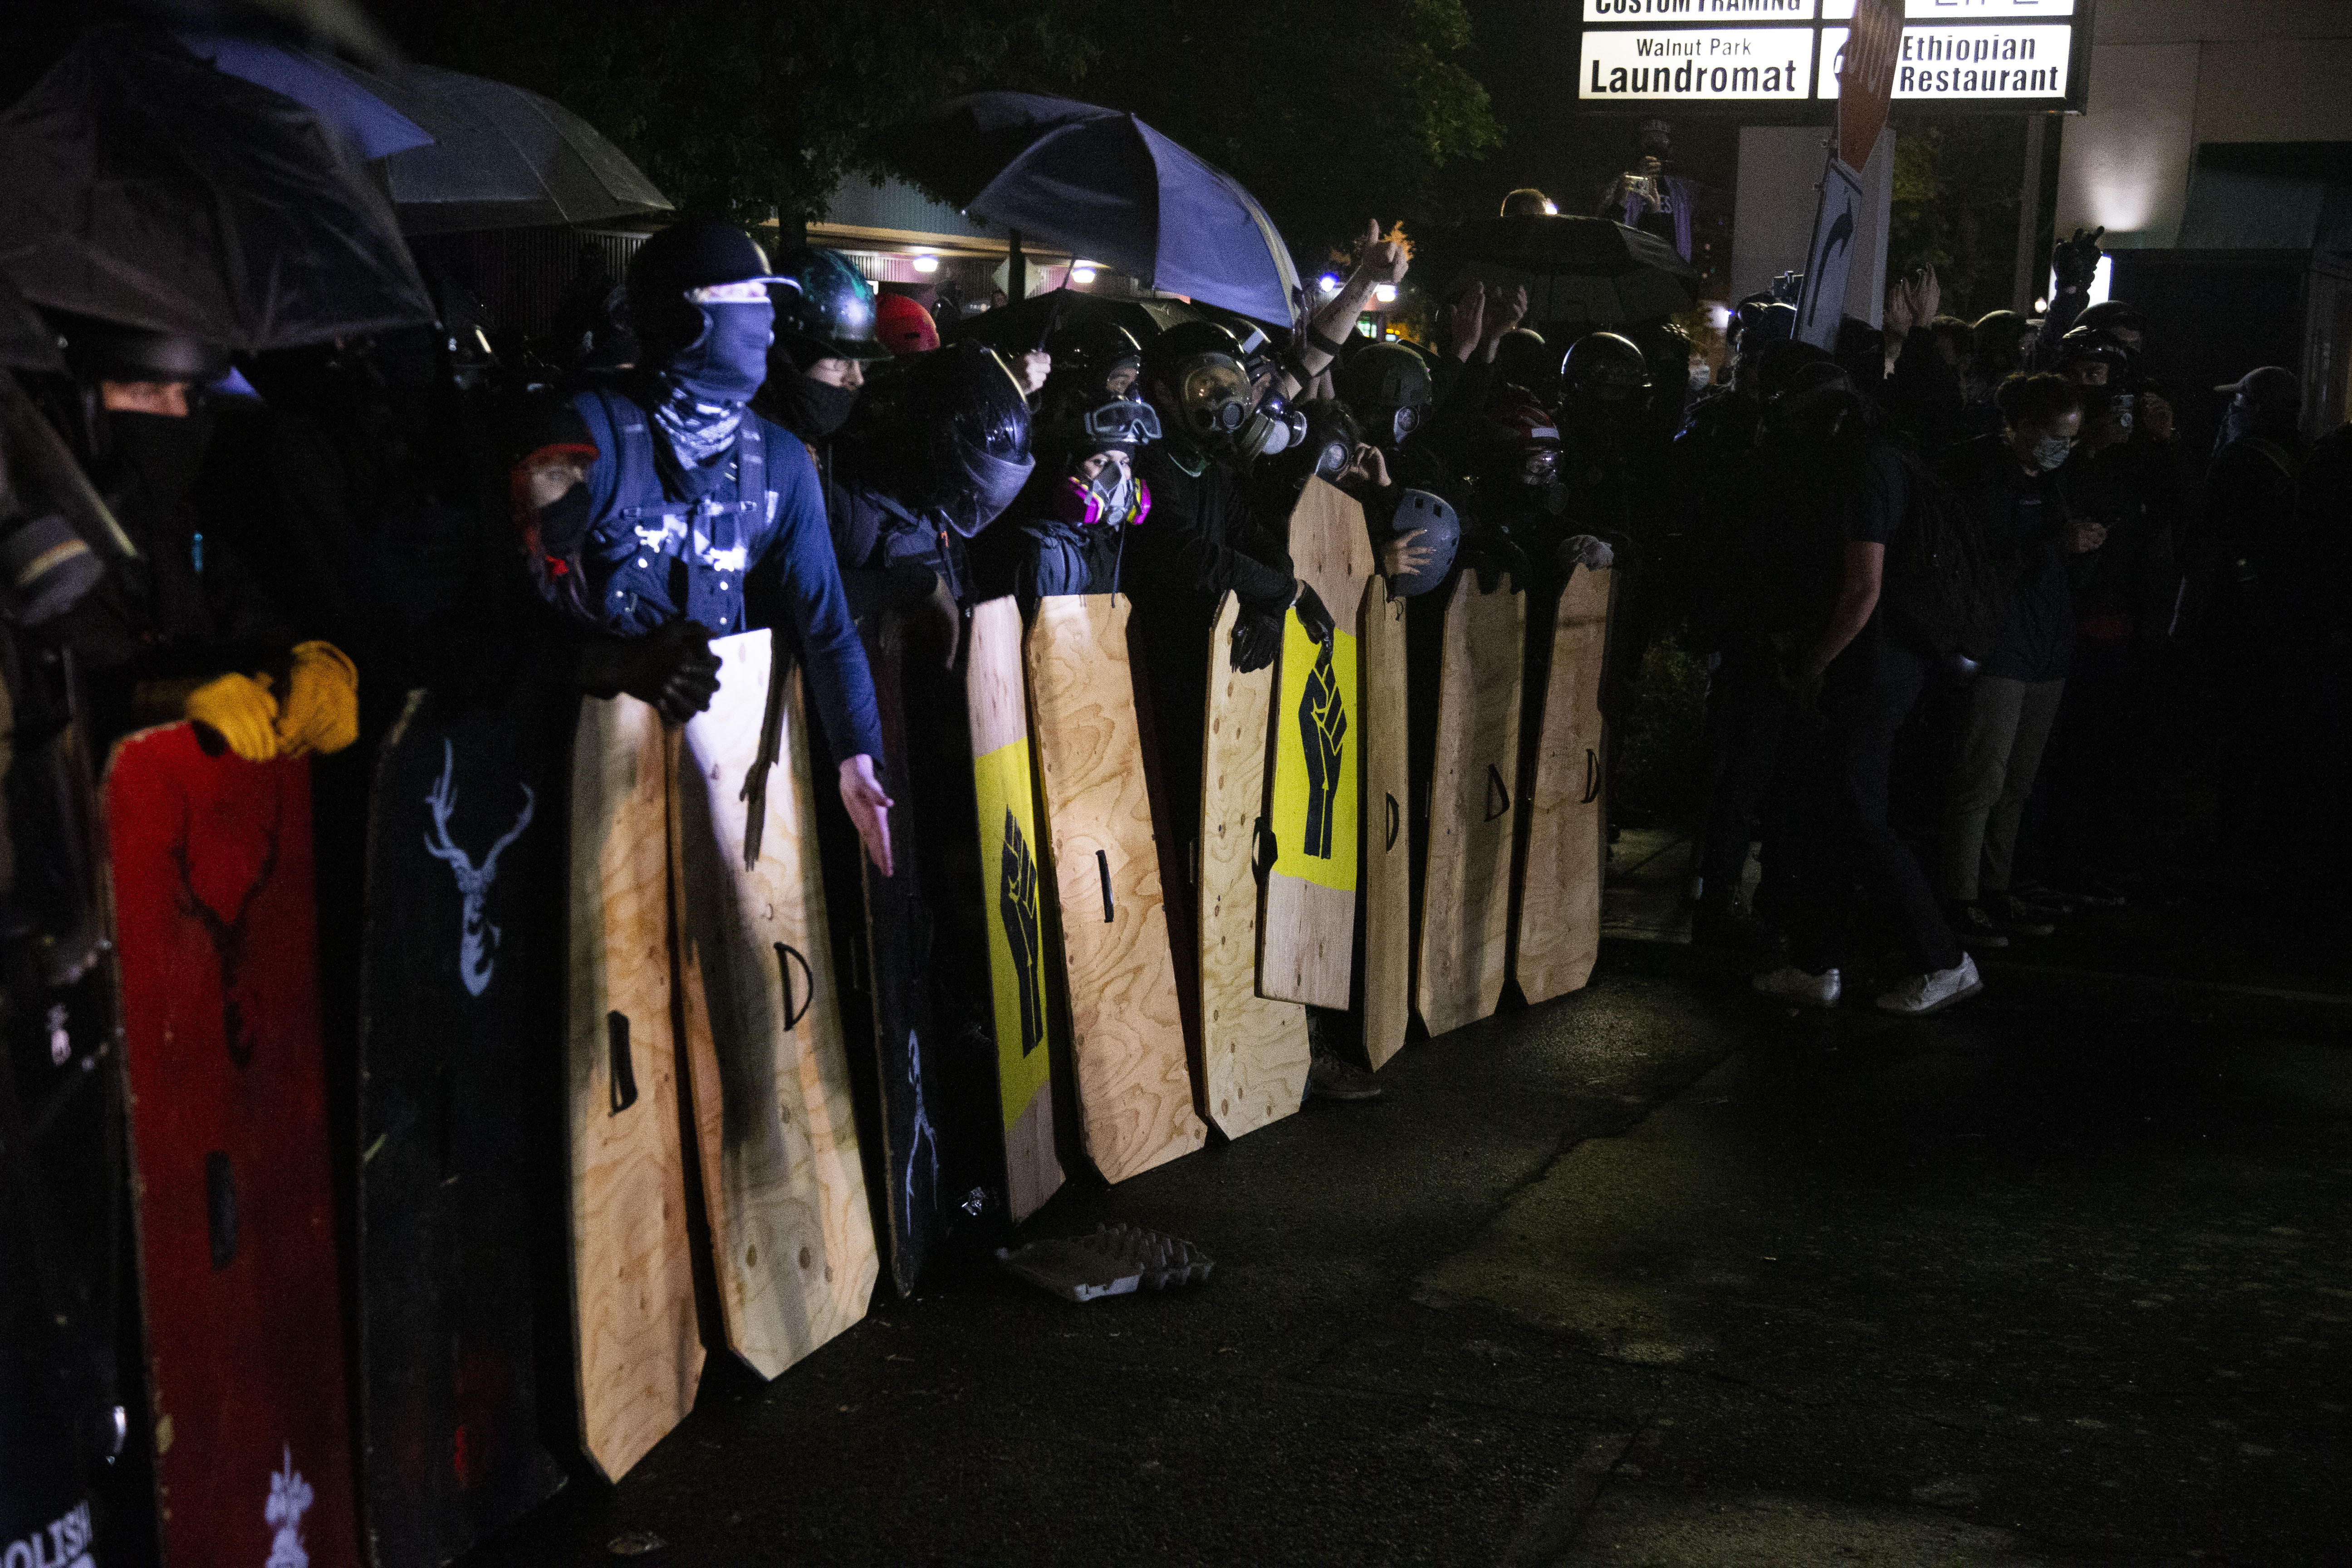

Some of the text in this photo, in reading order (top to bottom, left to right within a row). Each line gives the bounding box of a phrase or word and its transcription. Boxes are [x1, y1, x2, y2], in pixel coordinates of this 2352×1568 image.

[1637, 38, 1752, 56] Walnut Park
[1902, 35, 2035, 63] Ethiopian
[1591, 59, 1797, 93] Laundromat
[1900, 66, 2058, 92] Restaurant
